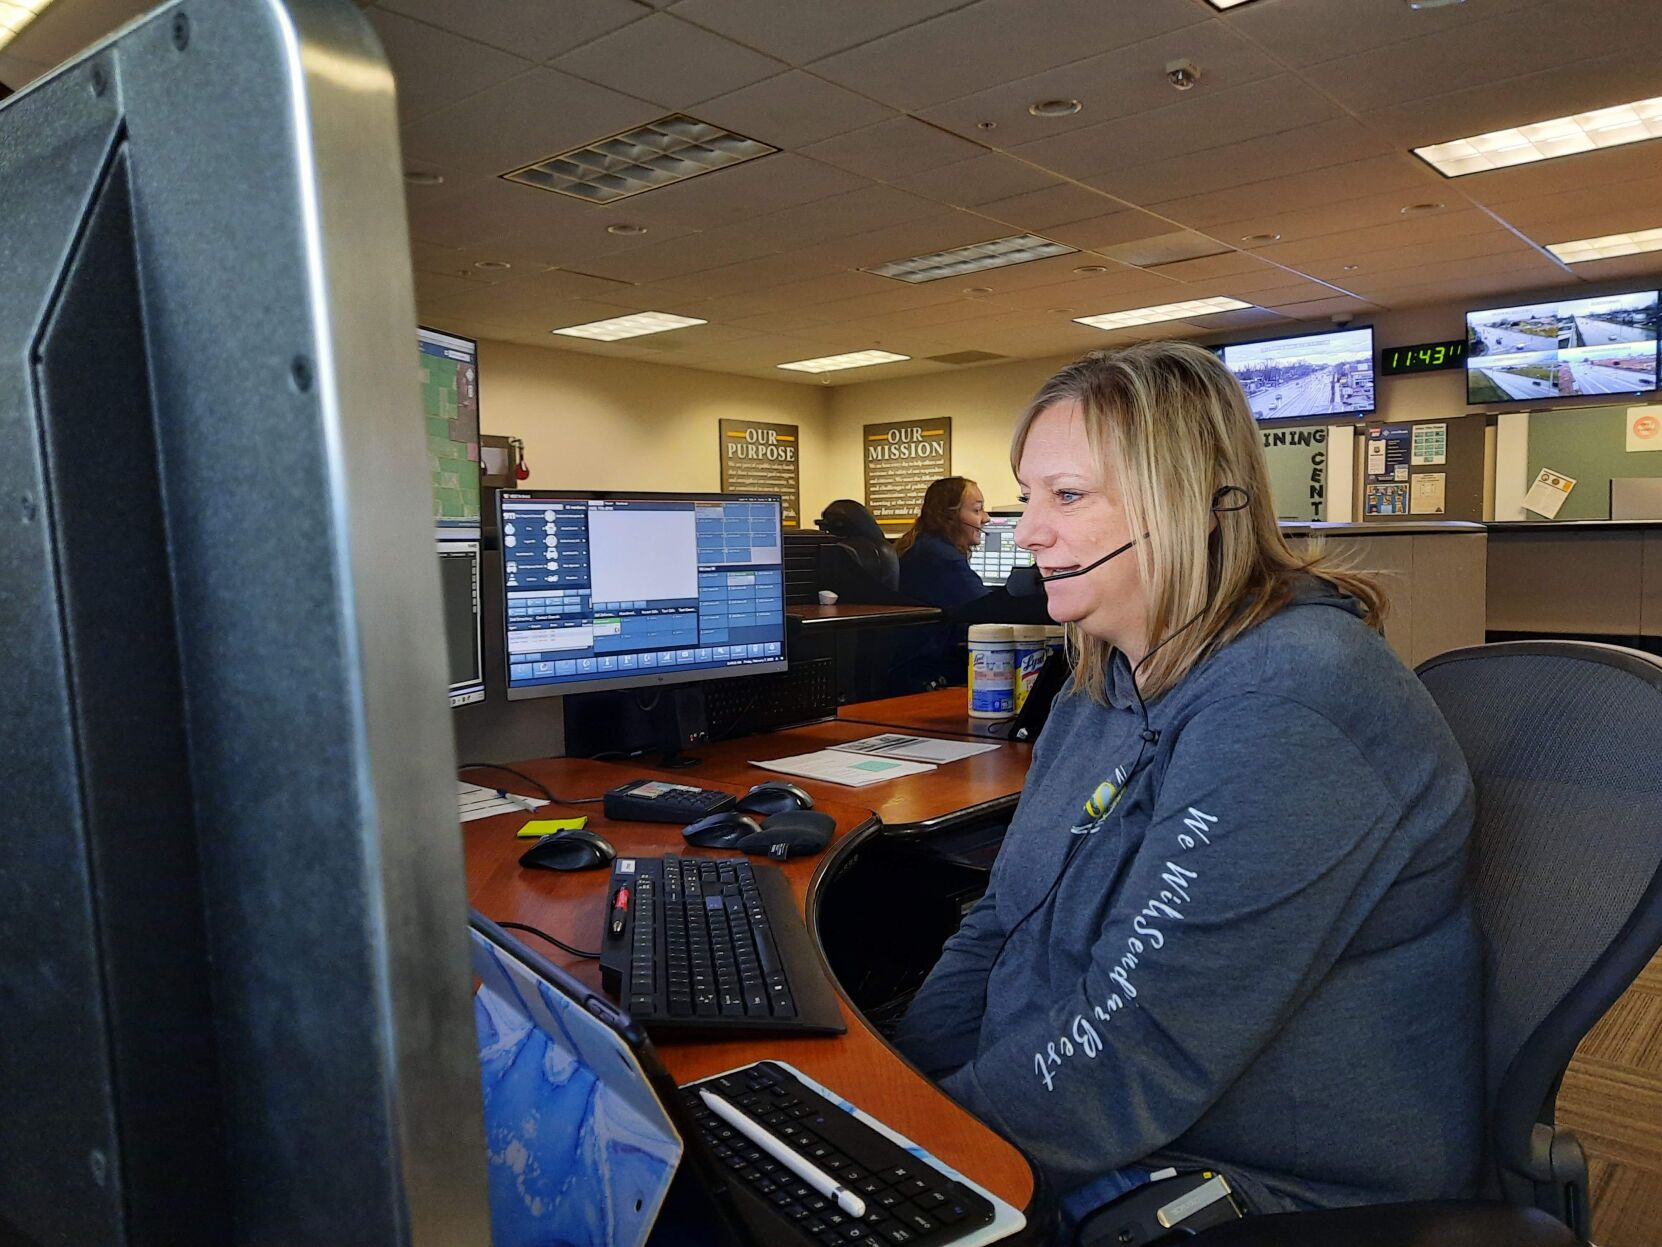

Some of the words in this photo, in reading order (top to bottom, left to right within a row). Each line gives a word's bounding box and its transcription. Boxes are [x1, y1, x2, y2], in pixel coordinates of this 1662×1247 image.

[746, 428, 777, 445] OUR
[888, 427, 923, 443] OUR
[728, 443, 795, 461] PURPOSE
[868, 441, 944, 461] MISSION
[1310, 451, 1325, 522] CENT
[1178, 807, 1219, 850] We
[1109, 916, 1164, 998] Send
[1095, 992, 1131, 1021] ur
[1034, 1014, 1103, 1092] Best
